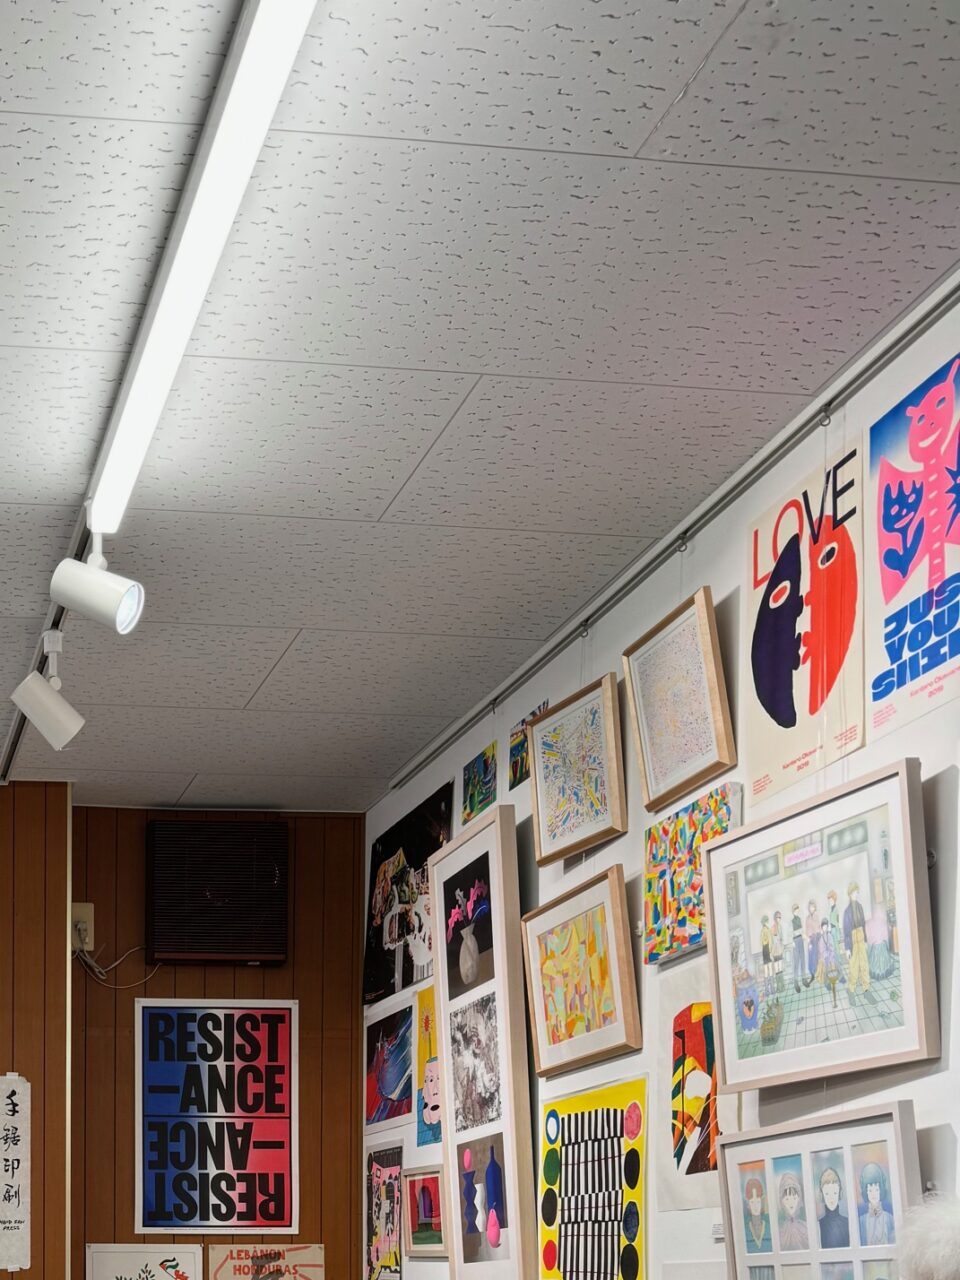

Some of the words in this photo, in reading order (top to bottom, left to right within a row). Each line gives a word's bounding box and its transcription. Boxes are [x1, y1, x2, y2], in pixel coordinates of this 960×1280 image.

[753, 448, 857, 591] LOVE
[148, 1012, 286, 1063] RESIST
[147, 1172, 286, 1222] RESIST
[233, 1264, 299, 1276] HONDURAS
